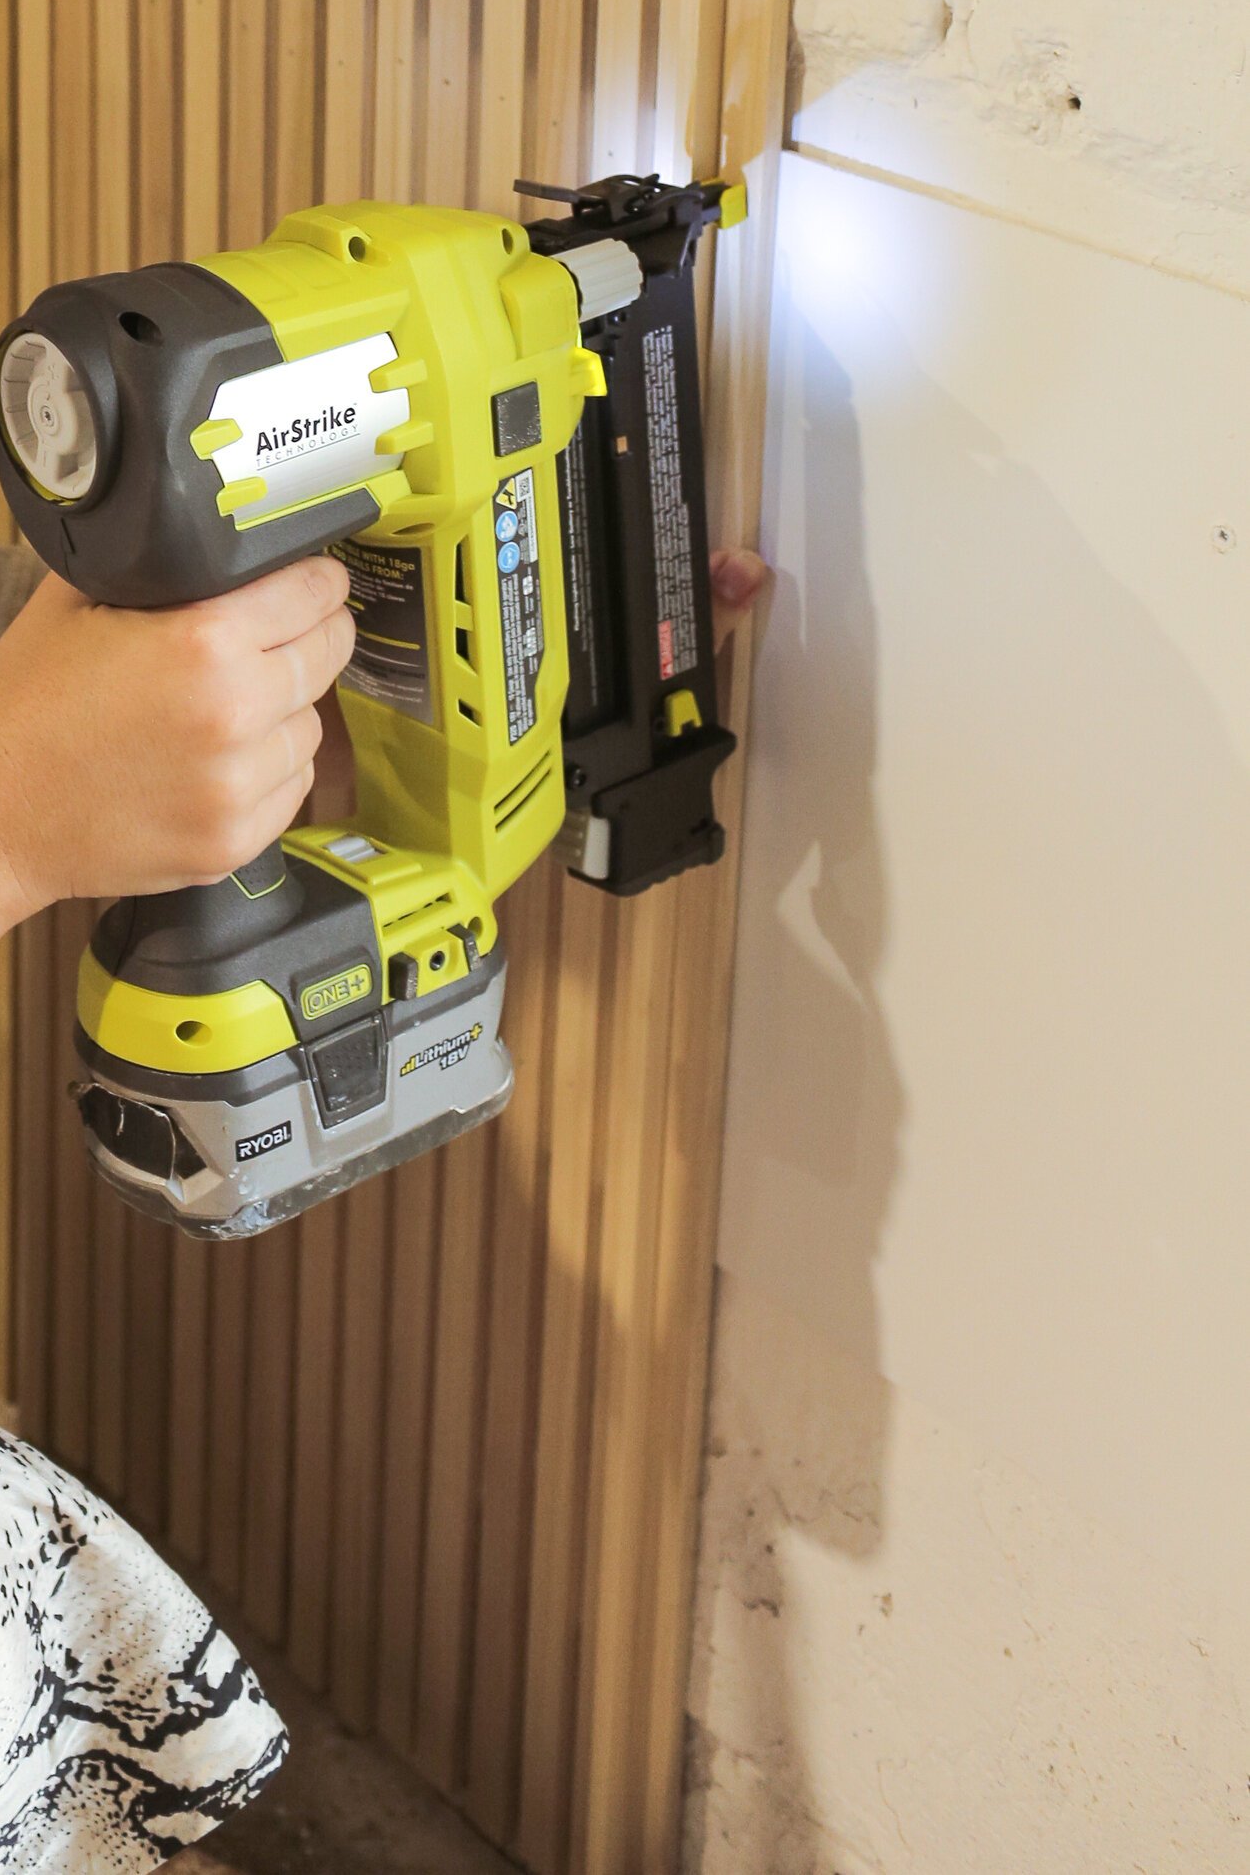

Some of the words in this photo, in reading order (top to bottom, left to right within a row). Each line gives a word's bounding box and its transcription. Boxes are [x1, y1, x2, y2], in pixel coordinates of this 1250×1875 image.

[256, 405, 356, 456] AirStrike
[256, 424, 358, 467] TECHNOLOGY
[372, 564, 405, 580] FROM:
[309, 974, 365, 1010] ONE+
[439, 1044, 469, 1070] 18V
[238, 1126, 288, 1157] RYOBI
